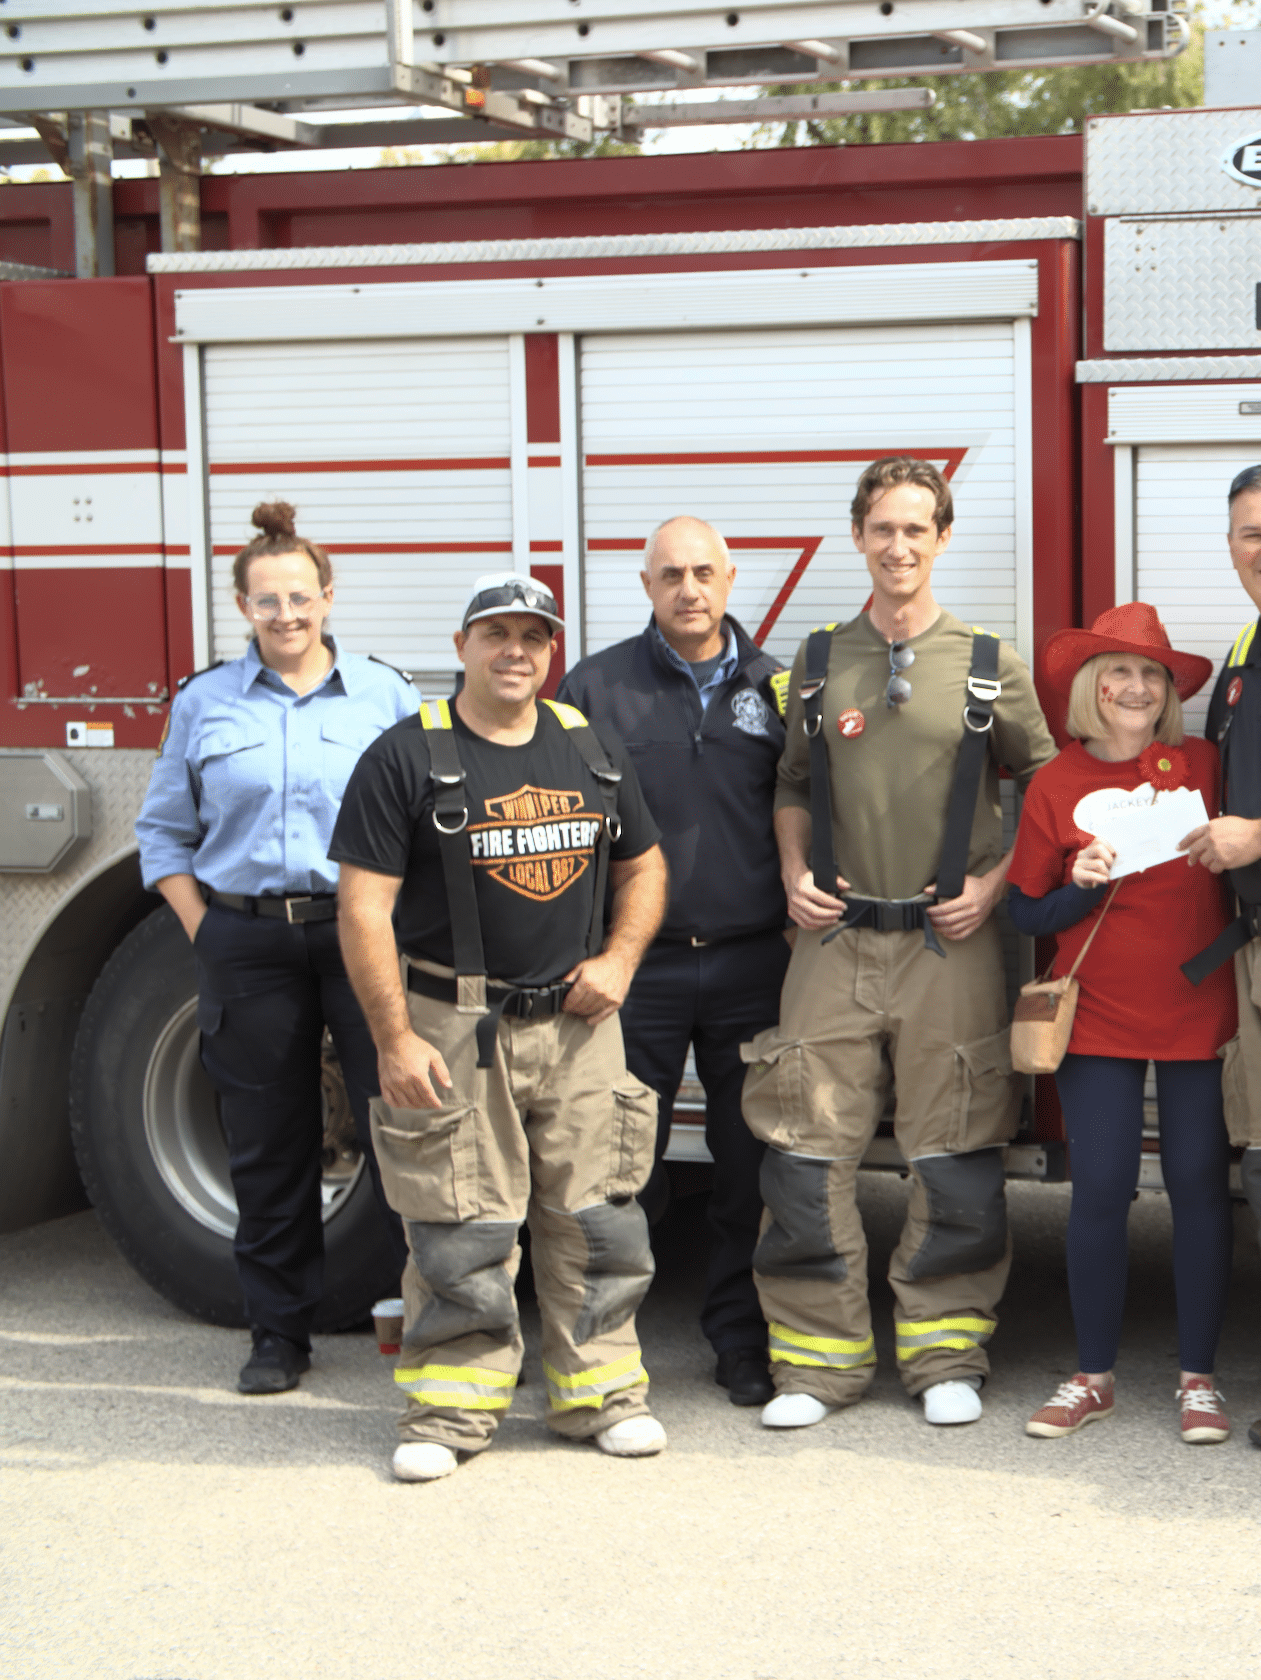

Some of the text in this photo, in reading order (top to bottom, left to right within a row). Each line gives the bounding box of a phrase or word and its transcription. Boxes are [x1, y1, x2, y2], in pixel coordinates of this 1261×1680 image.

[501, 793, 571, 820] WINNIPEG
[470, 829, 514, 858] FIRE
[508, 860, 551, 893] LOCAL
